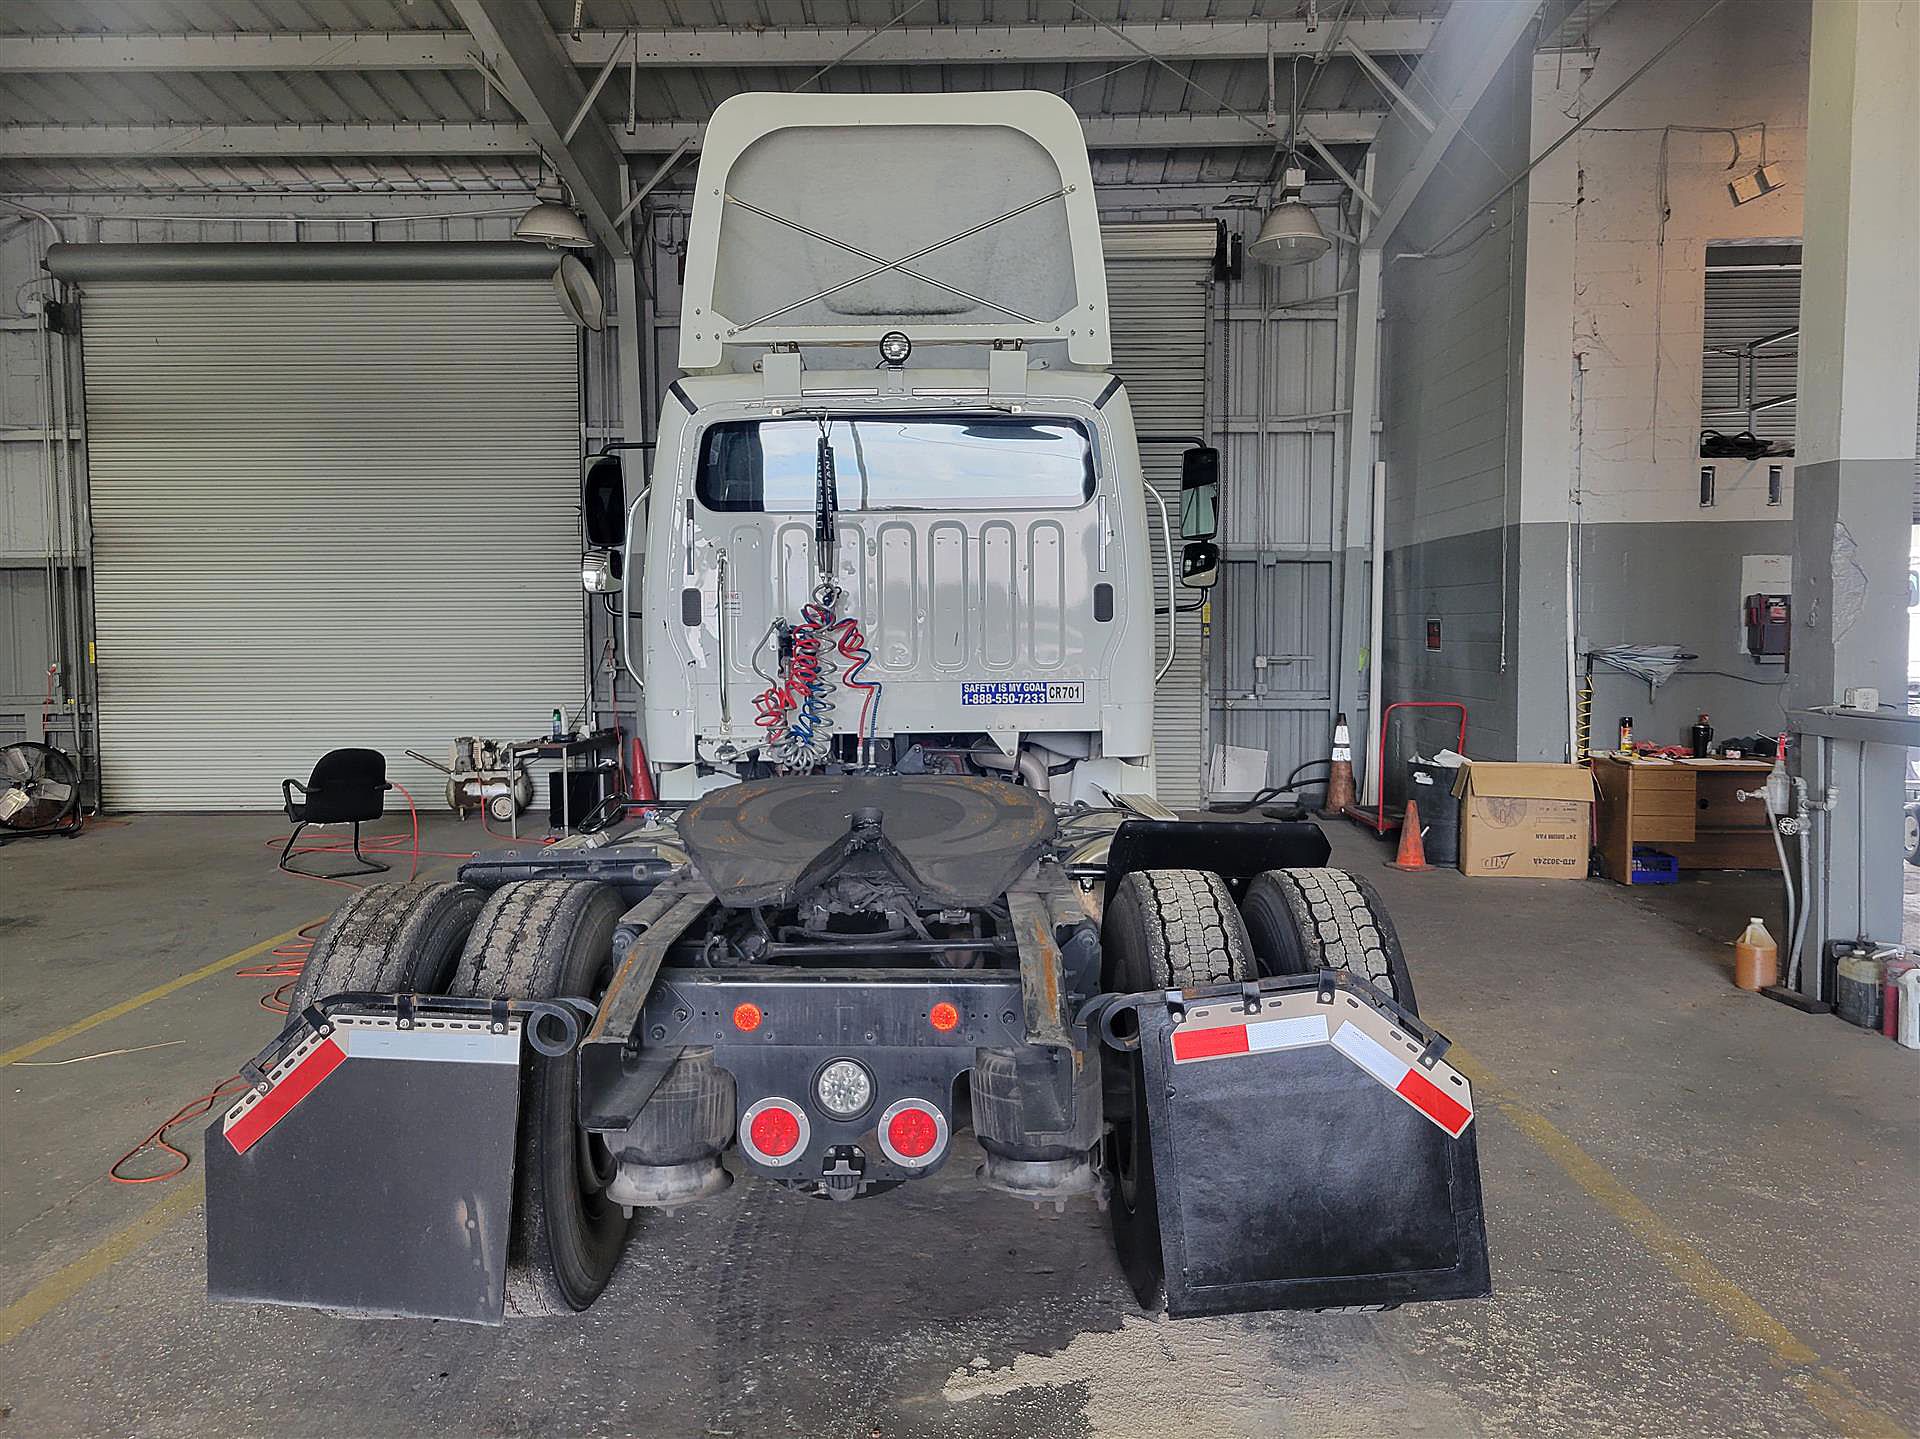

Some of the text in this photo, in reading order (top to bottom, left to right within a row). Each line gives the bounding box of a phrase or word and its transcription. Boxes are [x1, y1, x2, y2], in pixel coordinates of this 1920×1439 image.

[964, 682, 1046, 693] SAFETY IS MY GOAL
[1049, 686, 1080, 699] CR701
[962, 693, 1046, 704] 1-888-550-7233
